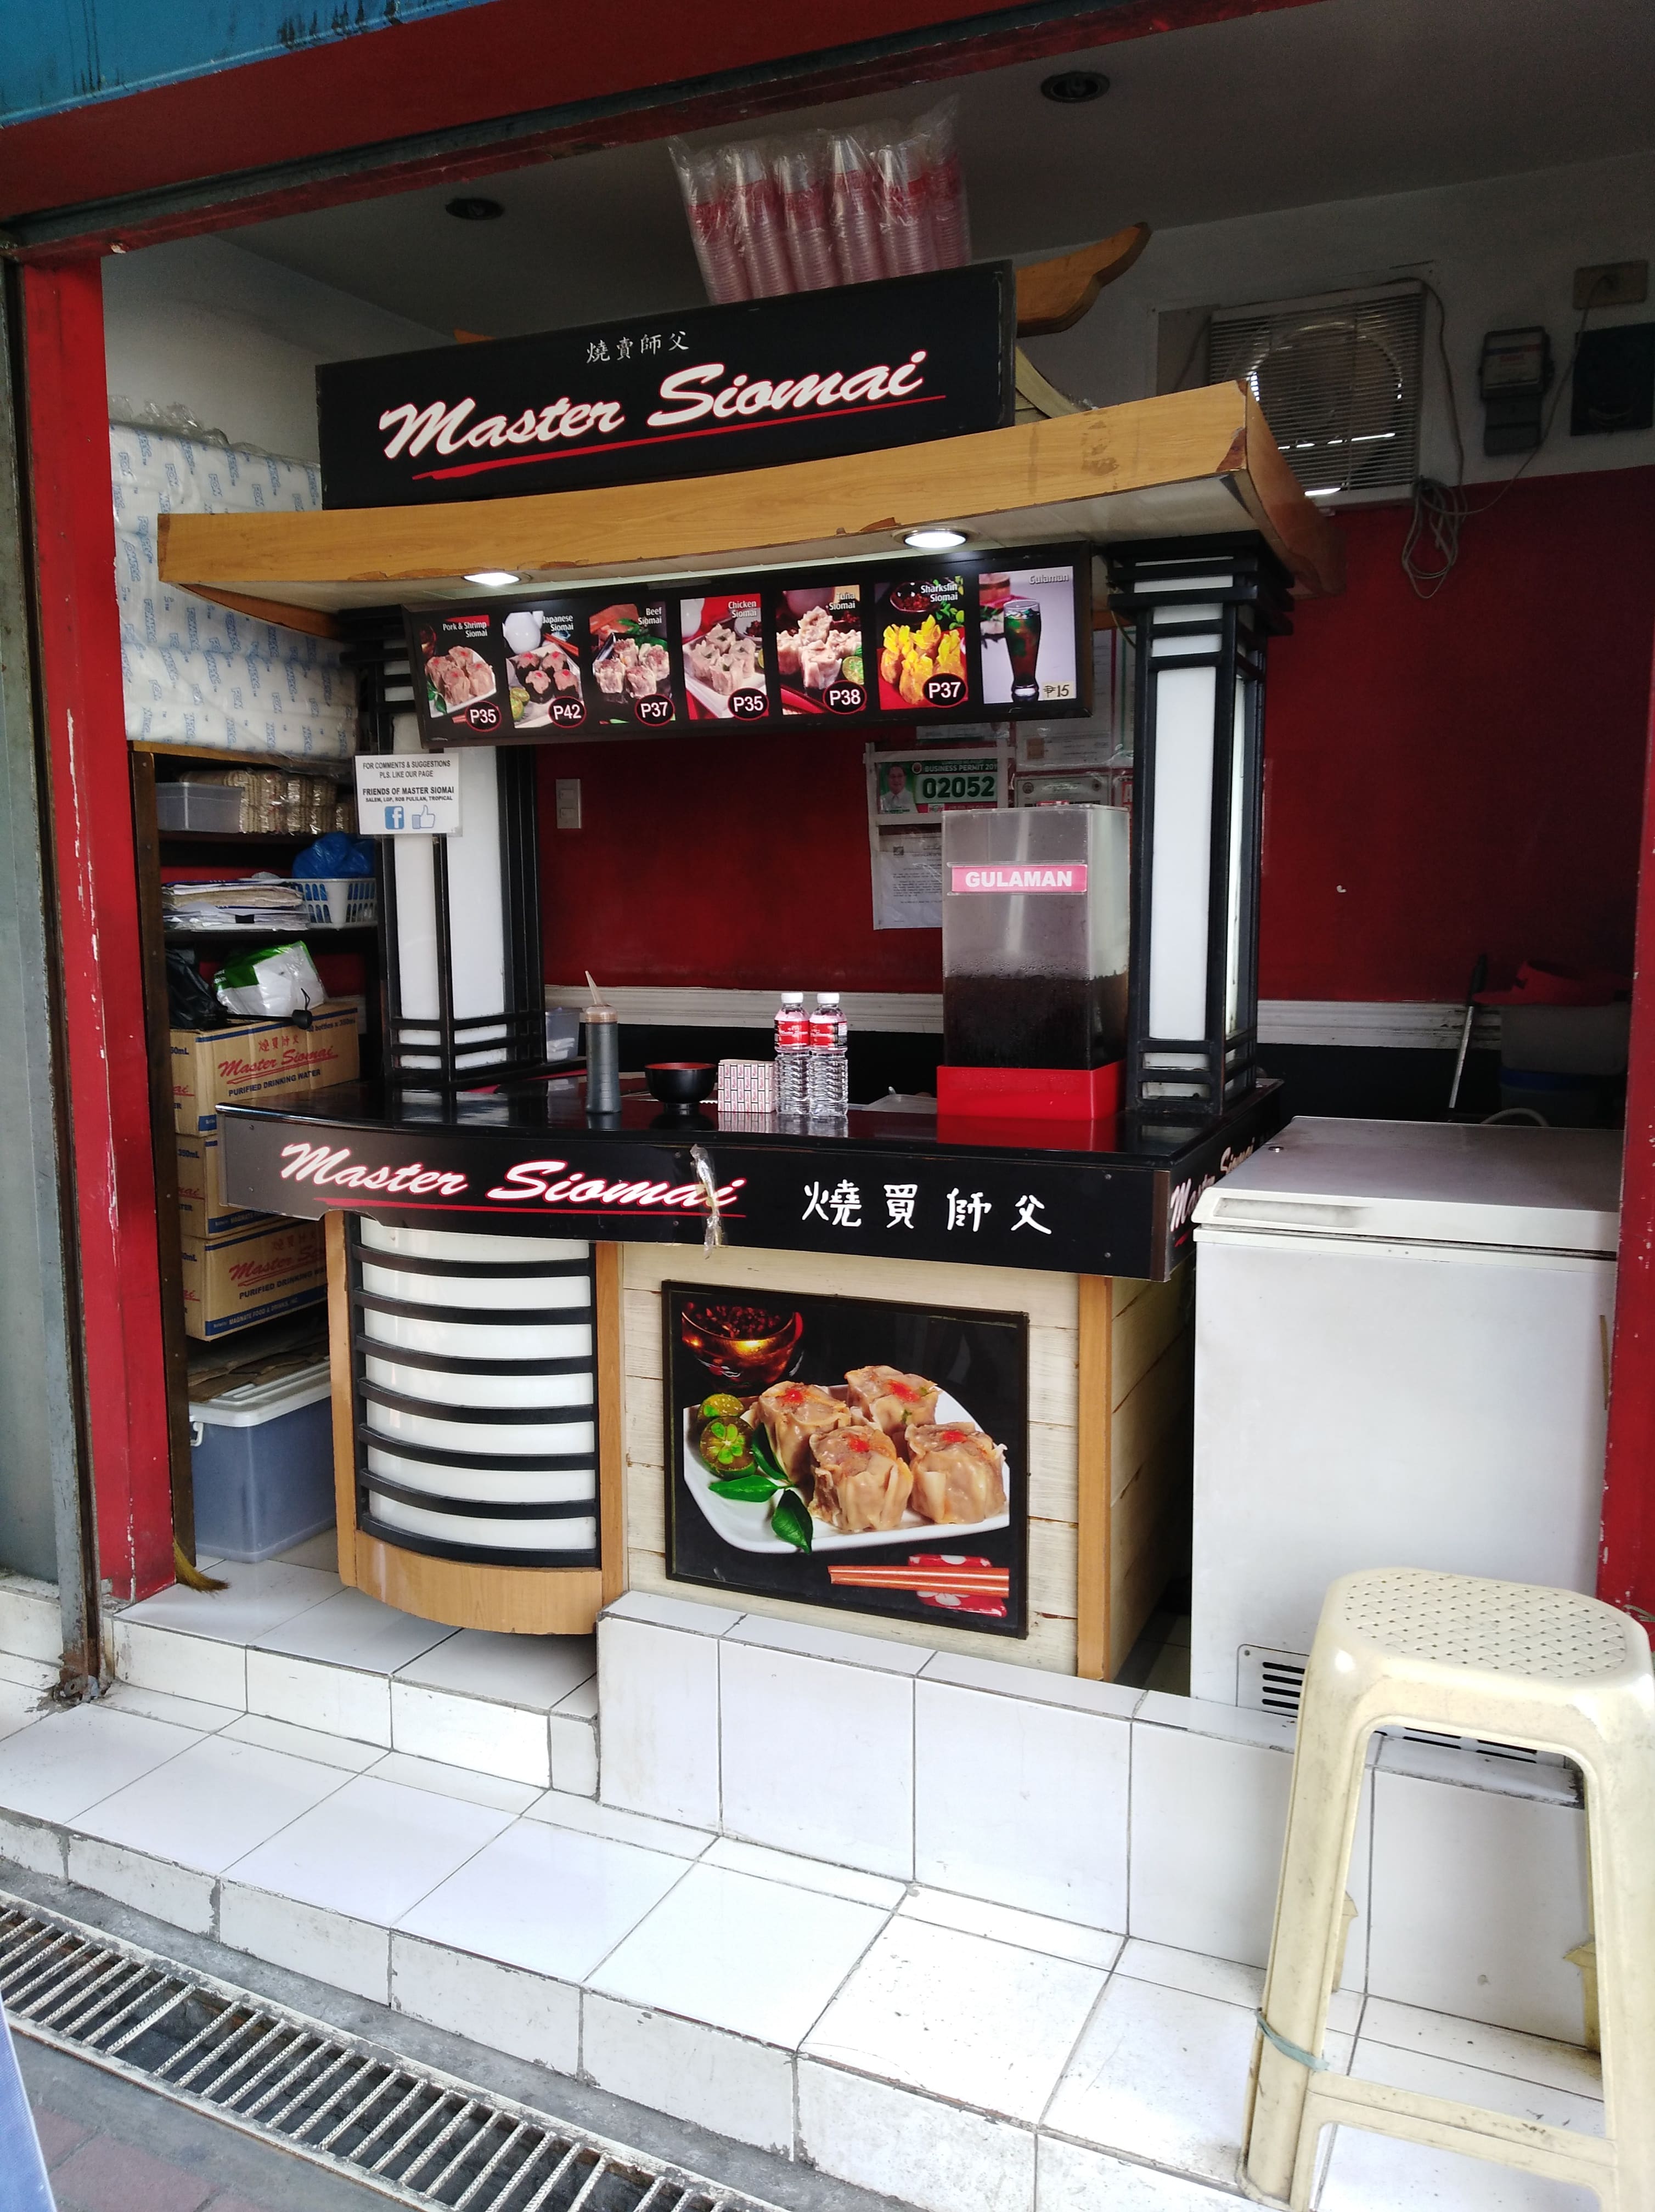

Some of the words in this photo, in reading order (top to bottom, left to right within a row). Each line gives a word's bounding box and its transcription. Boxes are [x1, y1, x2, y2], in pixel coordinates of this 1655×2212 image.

[587, 331, 689, 363] 燒賣師父
[379, 397, 624, 459] Master
[648, 351, 926, 426] Siomai
[1029, 574, 1069, 585] Gulaman
[921, 583, 958, 594] Sharksfin
[728, 600, 757, 610] Chicken
[930, 592, 958, 602] Siomai
[646, 607, 662, 616] Beef
[731, 609, 757, 618] Siomai
[829, 601, 855, 611] Siomai
[442, 623, 458, 631] Pork
[458, 622, 464, 630] &
[464, 620, 487, 629] Shrimp
[542, 615, 573, 624] Japanese
[550, 623, 574, 631] Siomai
[638, 617, 662, 625] Siomai
[465, 629, 488, 637] Siomai
[829, 689, 861, 706] P38
[928, 681, 961, 698] P37
[553, 703, 582, 720] P42
[640, 701, 668, 718] P37
[734, 695, 764, 713] P35
[470, 708, 497, 724] P35
[402, 787, 429, 795] MASTER
[922, 776, 995, 799] 02052
[965, 871, 1072, 888] GULAMAN
[218, 1058, 277, 1078] Master
[281, 1045, 334, 1065] Siomai
[228, 1083, 262, 1097] PURIFIED
[263, 1076, 296, 1088] DRINKING
[297, 1069, 320, 1081] WATER
[281, 1143, 468, 1196] Master
[487, 1160, 746, 1208] Siomai
[228, 1257, 292, 1281] Master
[239, 1283, 275, 1299] PURIFIED
[277, 1271, 313, 1288] DRINKING
